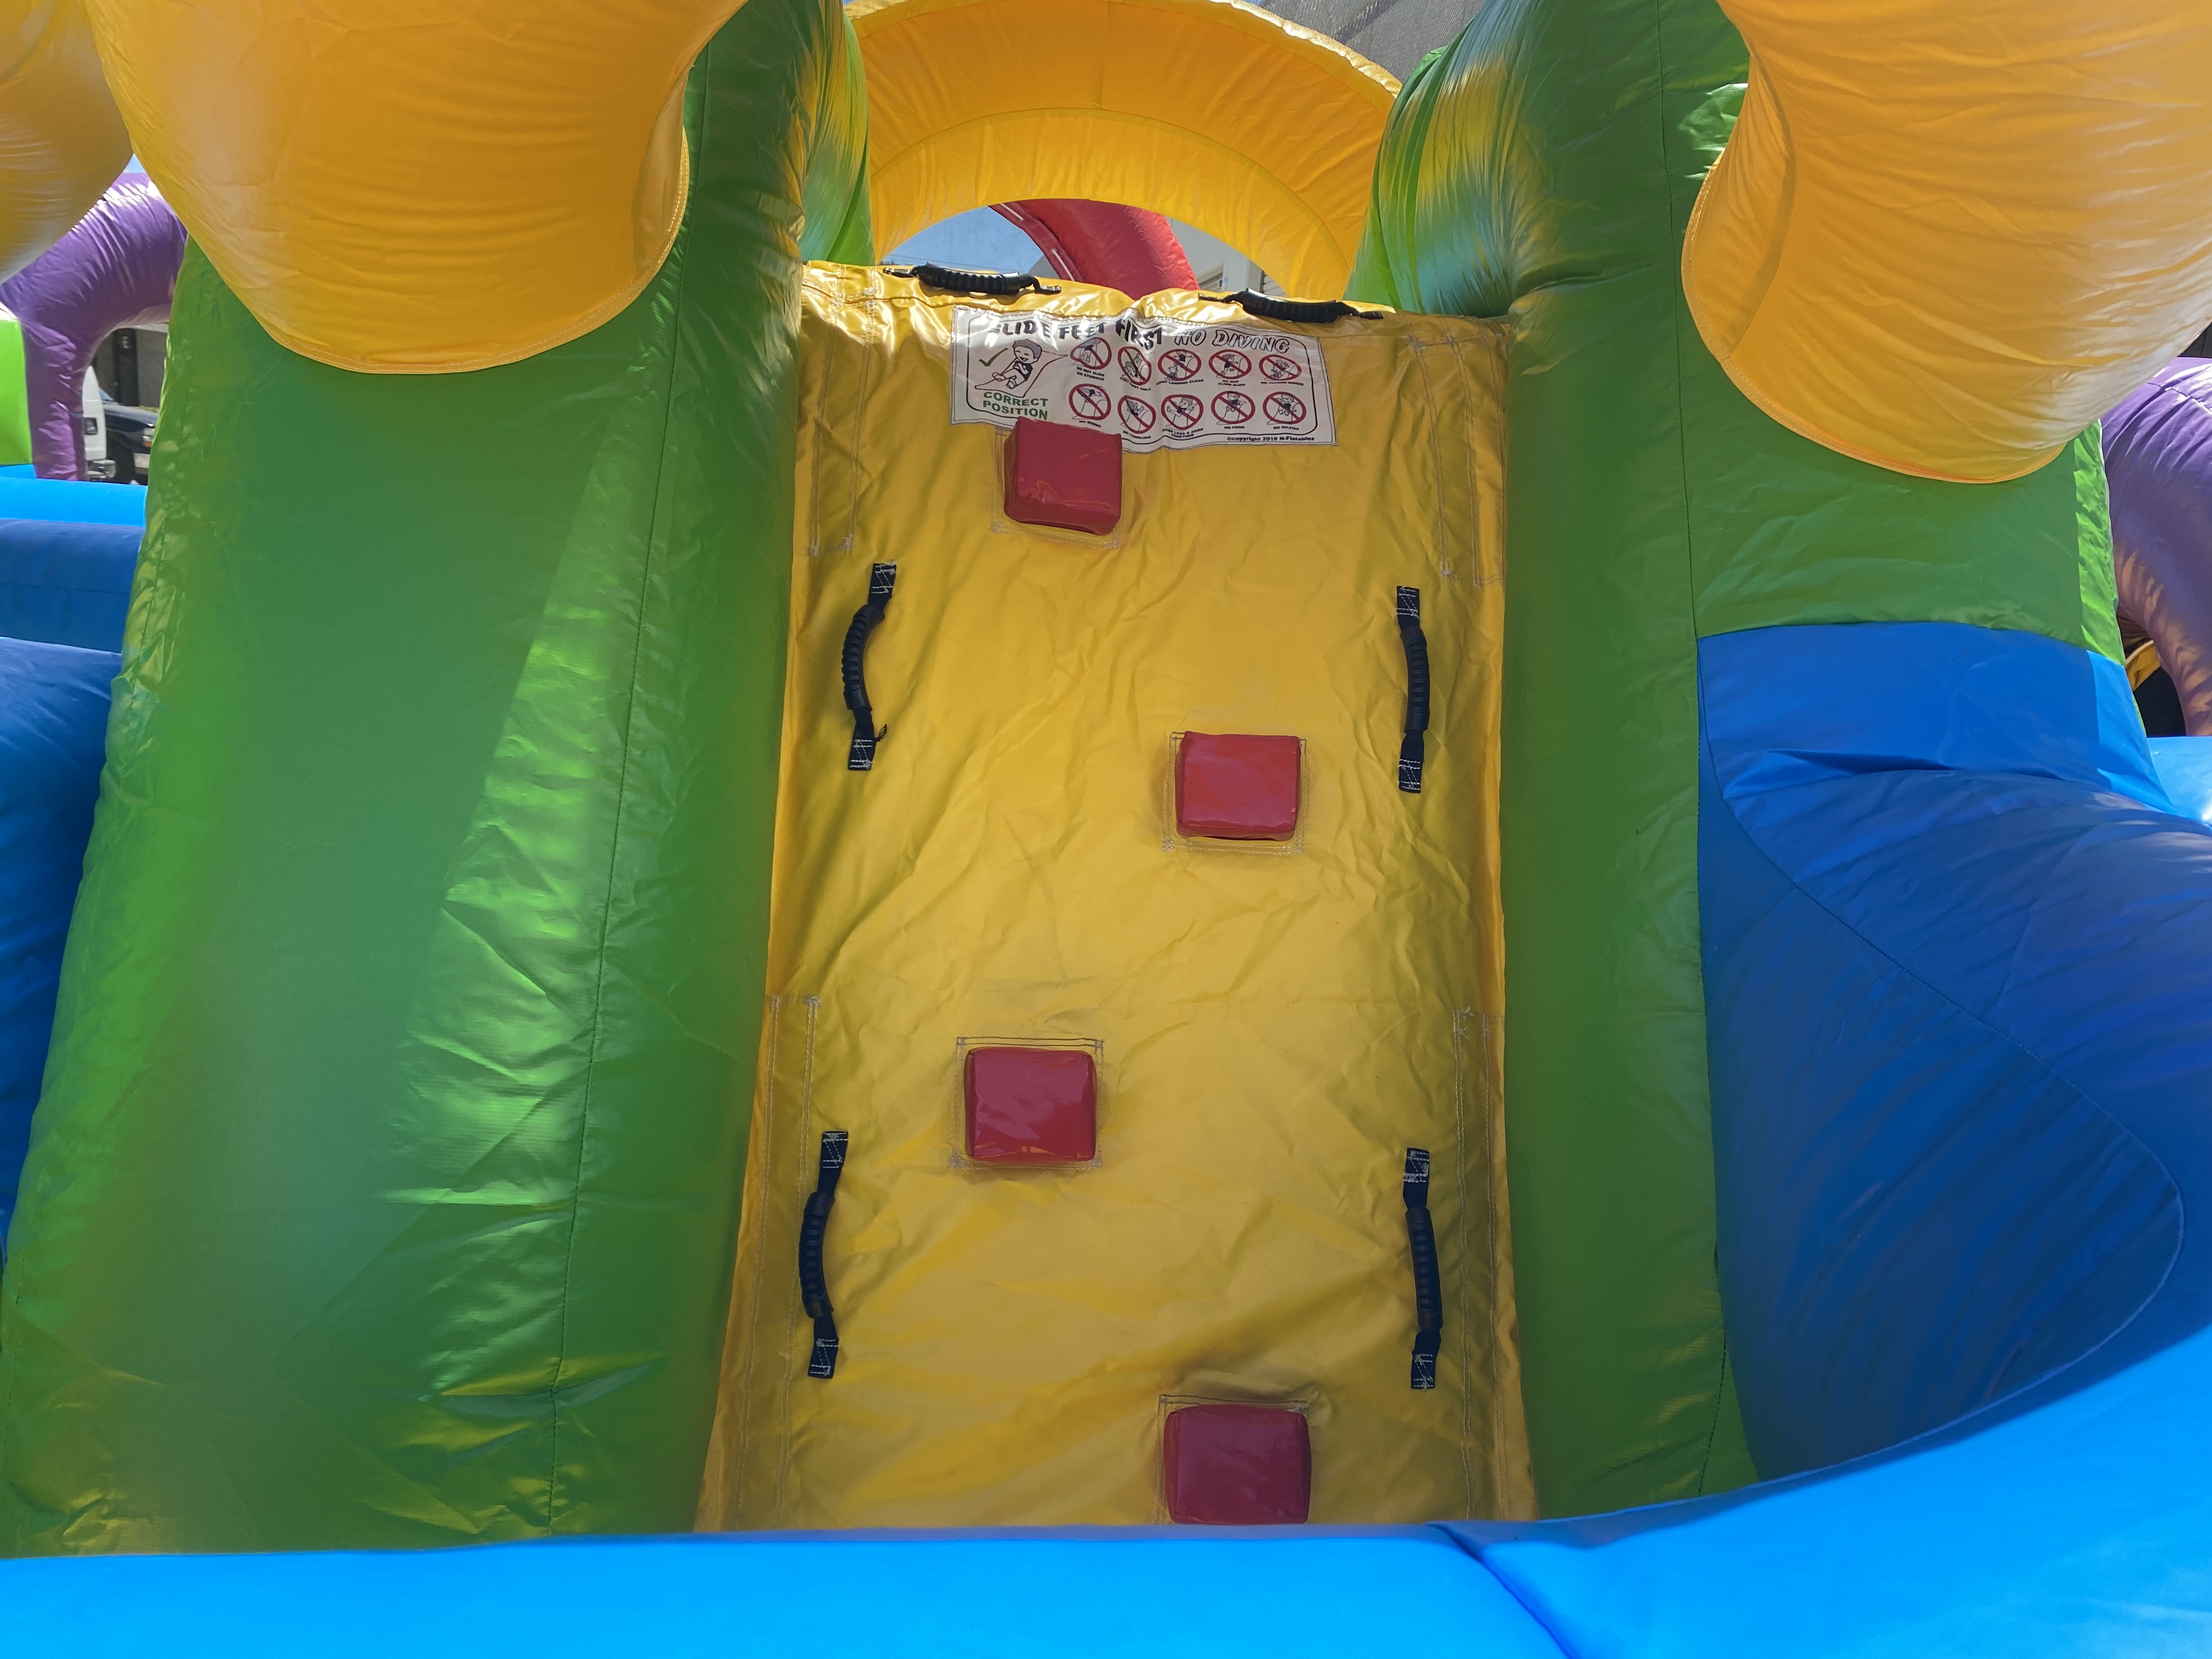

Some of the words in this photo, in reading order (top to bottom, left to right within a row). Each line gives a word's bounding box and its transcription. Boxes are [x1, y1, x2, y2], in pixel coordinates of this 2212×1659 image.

[1059, 322, 1107, 339] FEET
[1115, 318, 1163, 350] FIRST
[1174, 329, 1207, 346] NO
[1212, 329, 1290, 353] DIVING
[983, 391, 1048, 407] CORRECT
[983, 400, 1048, 420] POSITION
